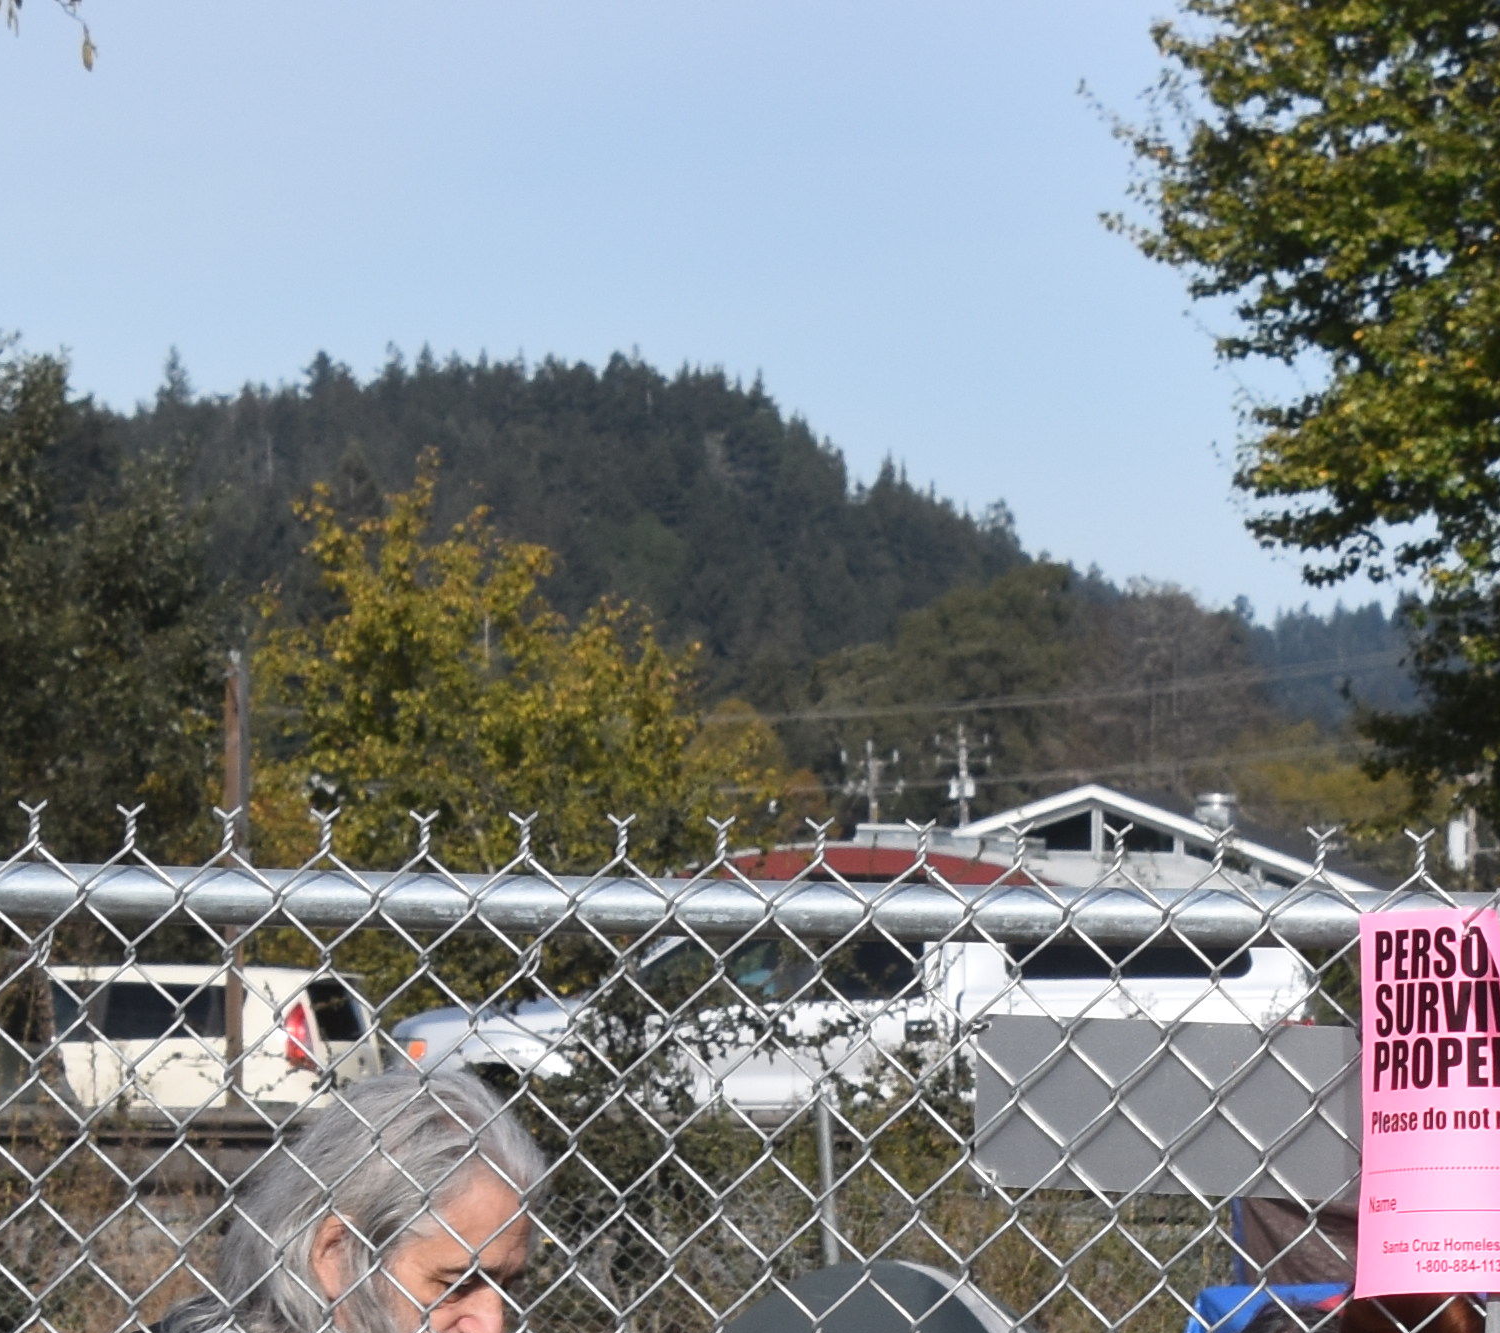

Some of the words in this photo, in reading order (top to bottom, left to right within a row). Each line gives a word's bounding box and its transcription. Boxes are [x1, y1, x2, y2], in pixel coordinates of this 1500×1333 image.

[1374, 925, 1500, 982] PERSO
[1371, 1110, 1418, 1135] Please
[1423, 1106, 1447, 1131] do
[1453, 1107, 1491, 1131] not
[1368, 1195, 1398, 1214] Name
[1382, 1240, 1410, 1255] Santa
[1411, 1238, 1440, 1253] Cruz
